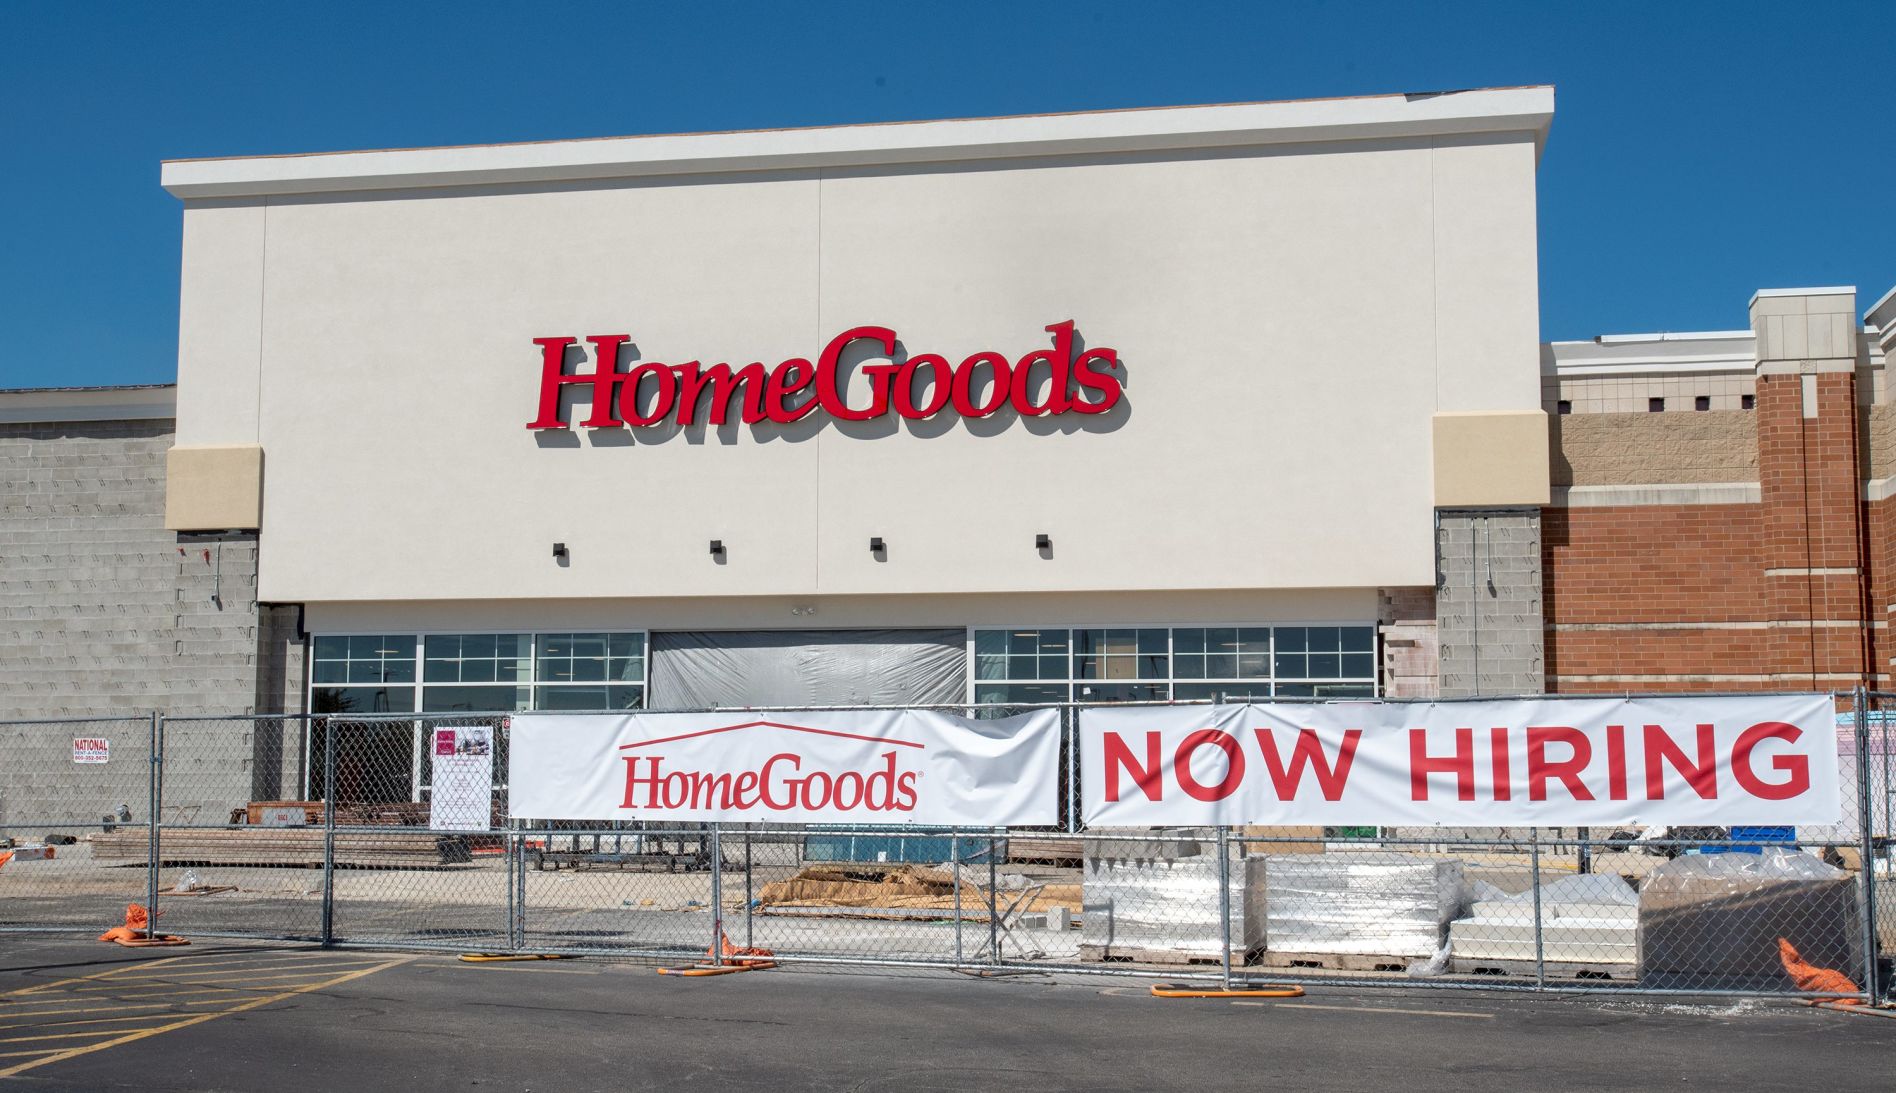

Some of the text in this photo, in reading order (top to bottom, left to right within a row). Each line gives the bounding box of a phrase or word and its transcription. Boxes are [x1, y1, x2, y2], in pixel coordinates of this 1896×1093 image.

[526, 319, 1121, 430] HomeGoods
[75, 739, 107, 751] NATIONAL
[1104, 721, 1810, 803] NOW HIRING
